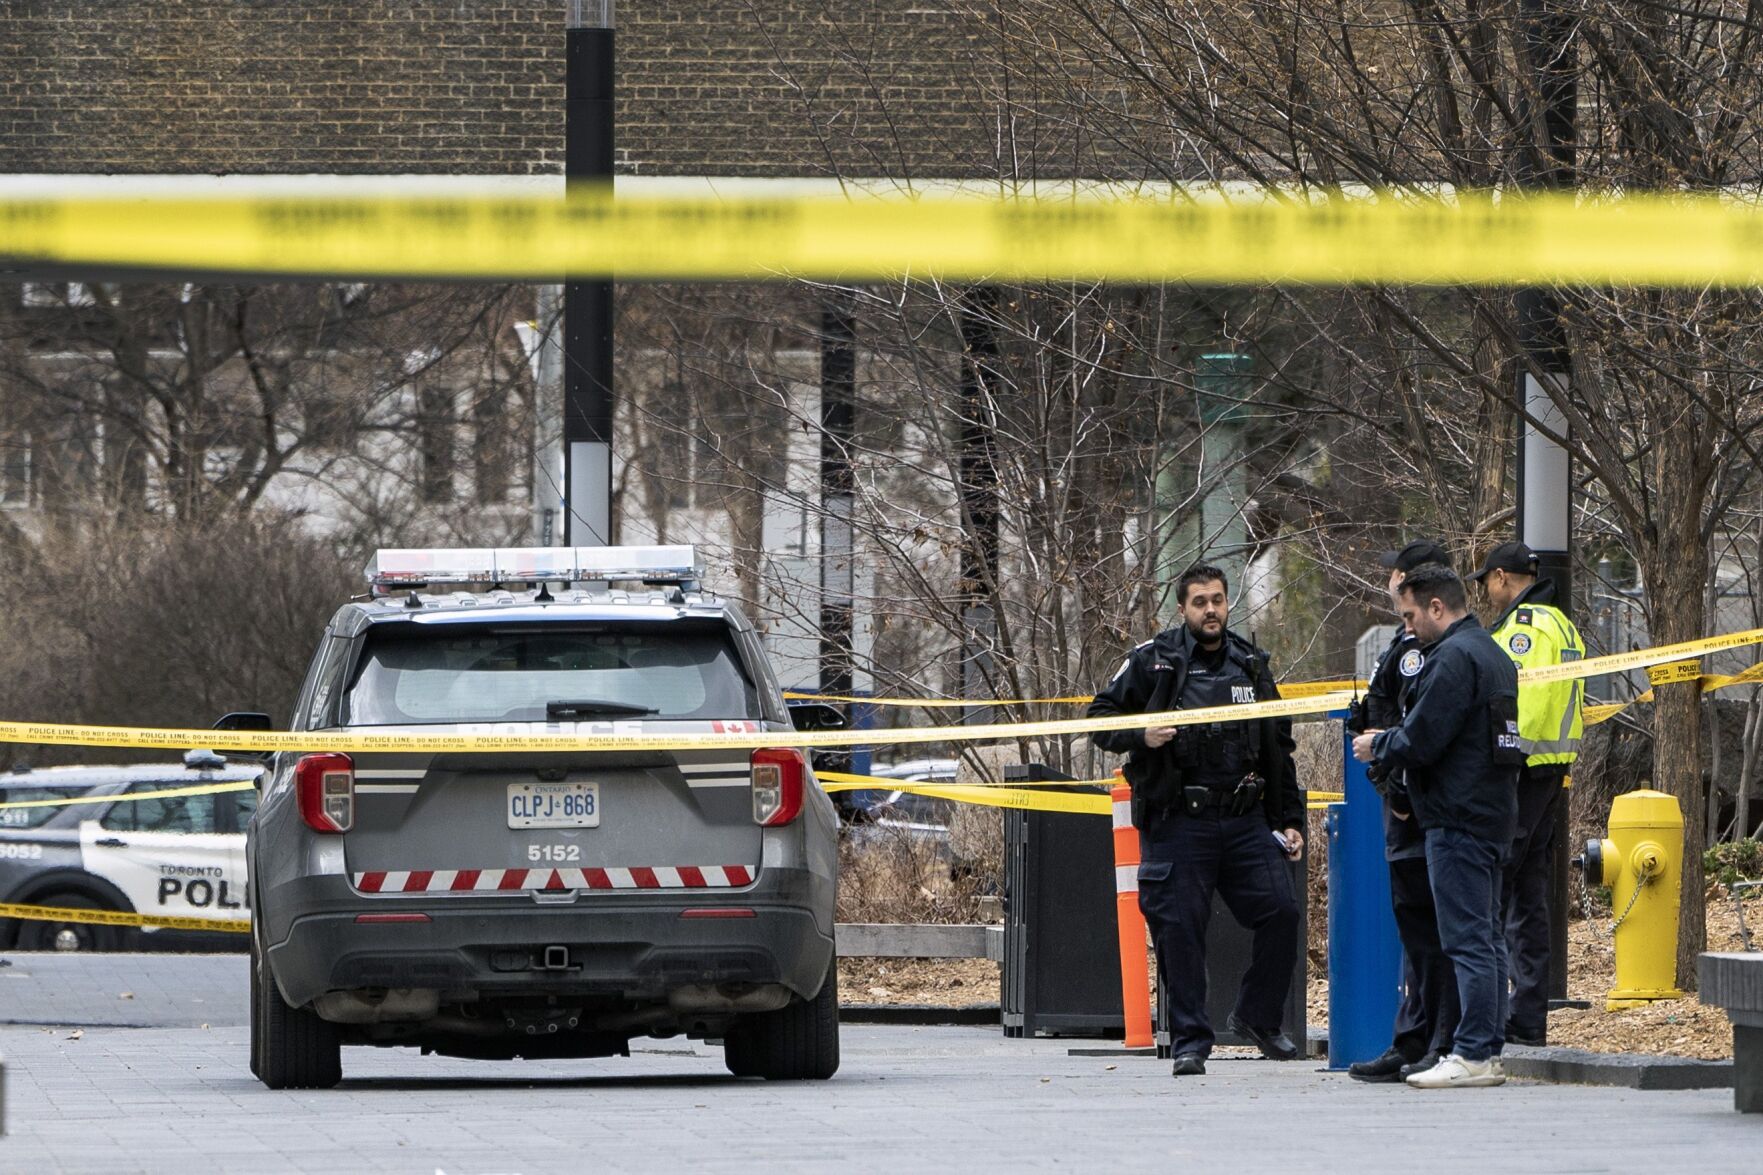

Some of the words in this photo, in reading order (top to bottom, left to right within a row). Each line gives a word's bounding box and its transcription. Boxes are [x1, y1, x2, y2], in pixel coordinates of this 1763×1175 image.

[1704, 640, 1730, 649] POLICE
[1561, 665, 1582, 673] CROSS
[1594, 658, 1620, 667] POLICE
[1231, 686, 1256, 703] POLICE
[512, 795, 553, 817] CLPJ
[564, 794, 595, 816] 868
[528, 845, 580, 861] 5152
[159, 864, 223, 877] TORONTO
